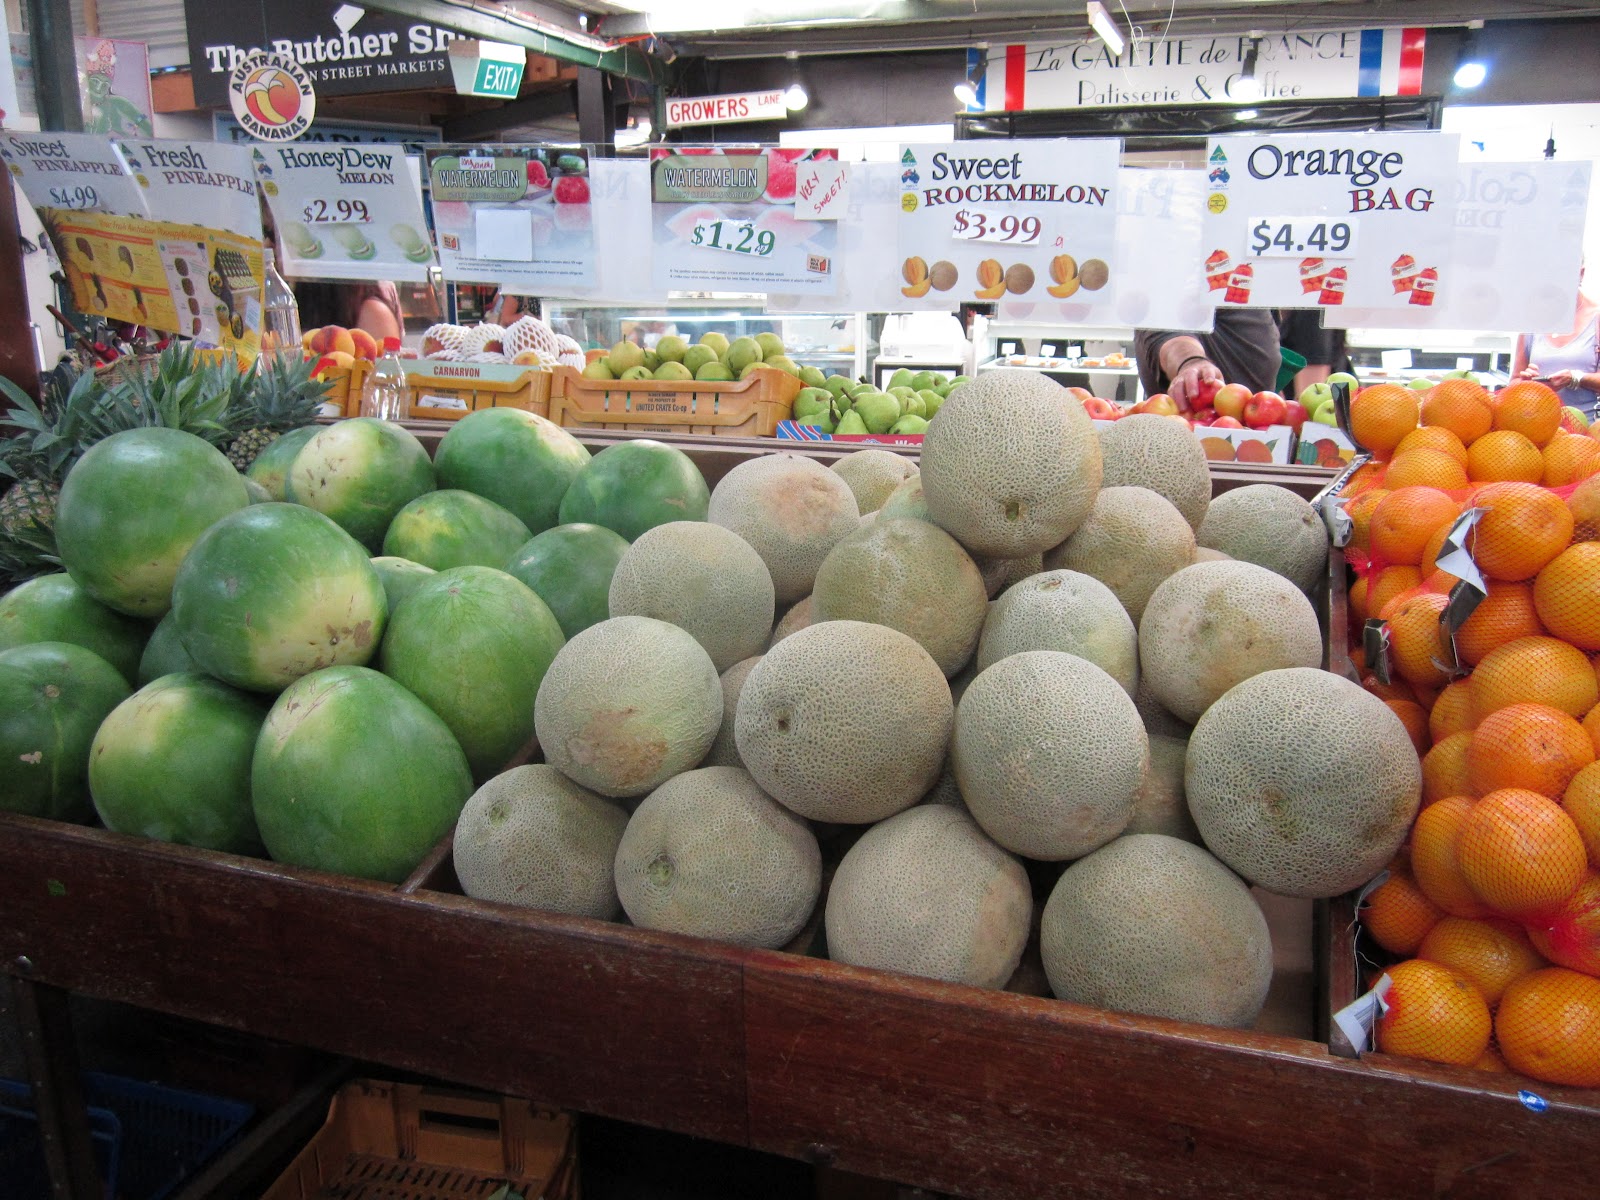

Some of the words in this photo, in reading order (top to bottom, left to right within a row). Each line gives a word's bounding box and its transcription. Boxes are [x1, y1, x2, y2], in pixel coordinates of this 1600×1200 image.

[1027, 47, 1065, 73] La
[1200, 39, 1230, 64] de
[1238, 32, 1356, 62] FRANCE
[232, 55, 312, 96] AUSTRALIAN
[322, 65, 373, 81] STREET
[377, 59, 446, 76] MARKETS
[483, 64, 513, 91] EXIT
[1078, 80, 1181, 105] Patisserie
[1191, 74, 1213, 102] &
[1224, 71, 1302, 99] Cffee
[670, 97, 749, 123] GROWERS
[757, 94, 781, 106] LANE
[241, 115, 308, 139] BANANAS
[9, 137, 70, 159] Sweet
[142, 145, 207, 170] Fresh
[278, 147, 393, 172] HoneyDew
[32, 159, 123, 177] PINEAPPLE
[664, 168, 758, 188] WATERMELON
[932, 151, 1023, 181] Sweet
[1247, 144, 1403, 187] Orange
[162, 171, 255, 196] PINEAPPLE
[337, 173, 395, 185] MELON
[439, 170, 519, 188] WATERMELON
[799, 170, 820, 201] VERY
[50, 185, 98, 208] $4.99
[923, 183, 1110, 208] ROCKMELON
[1348, 187, 1435, 213] BAG
[303, 199, 369, 222] $2.99
[953, 208, 1042, 243] $3.99
[1251, 219, 1351, 257] $4.49
[690, 221, 776, 256] $1.29
[433, 365, 481, 378] CARNARVON
[636, 403, 654, 411] UNITED
[656, 403, 671, 412] CRATE
